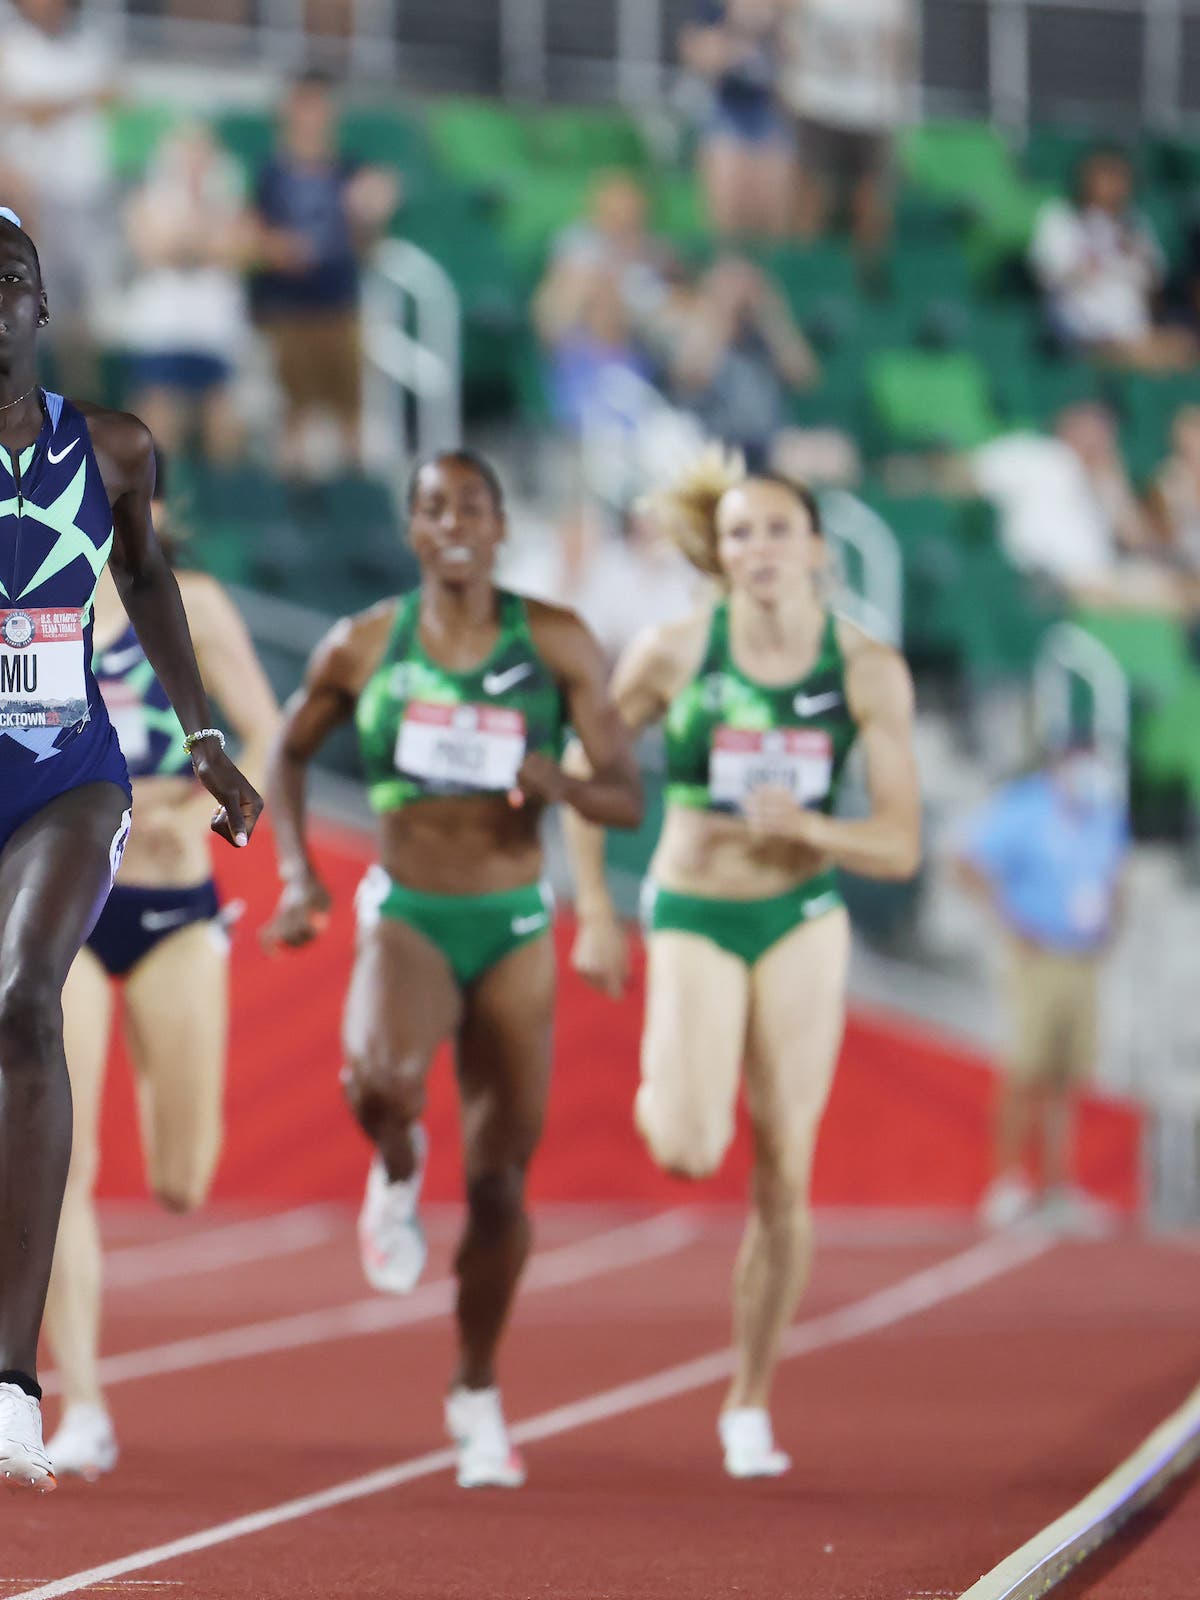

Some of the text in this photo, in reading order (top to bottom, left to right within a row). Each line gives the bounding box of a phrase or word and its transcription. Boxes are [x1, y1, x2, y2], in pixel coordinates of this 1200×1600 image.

[40, 612, 78, 623] U.S. OLYMPIC
[40, 622, 76, 634] TEAM TRIALS
[0, 654, 38, 693] MU
